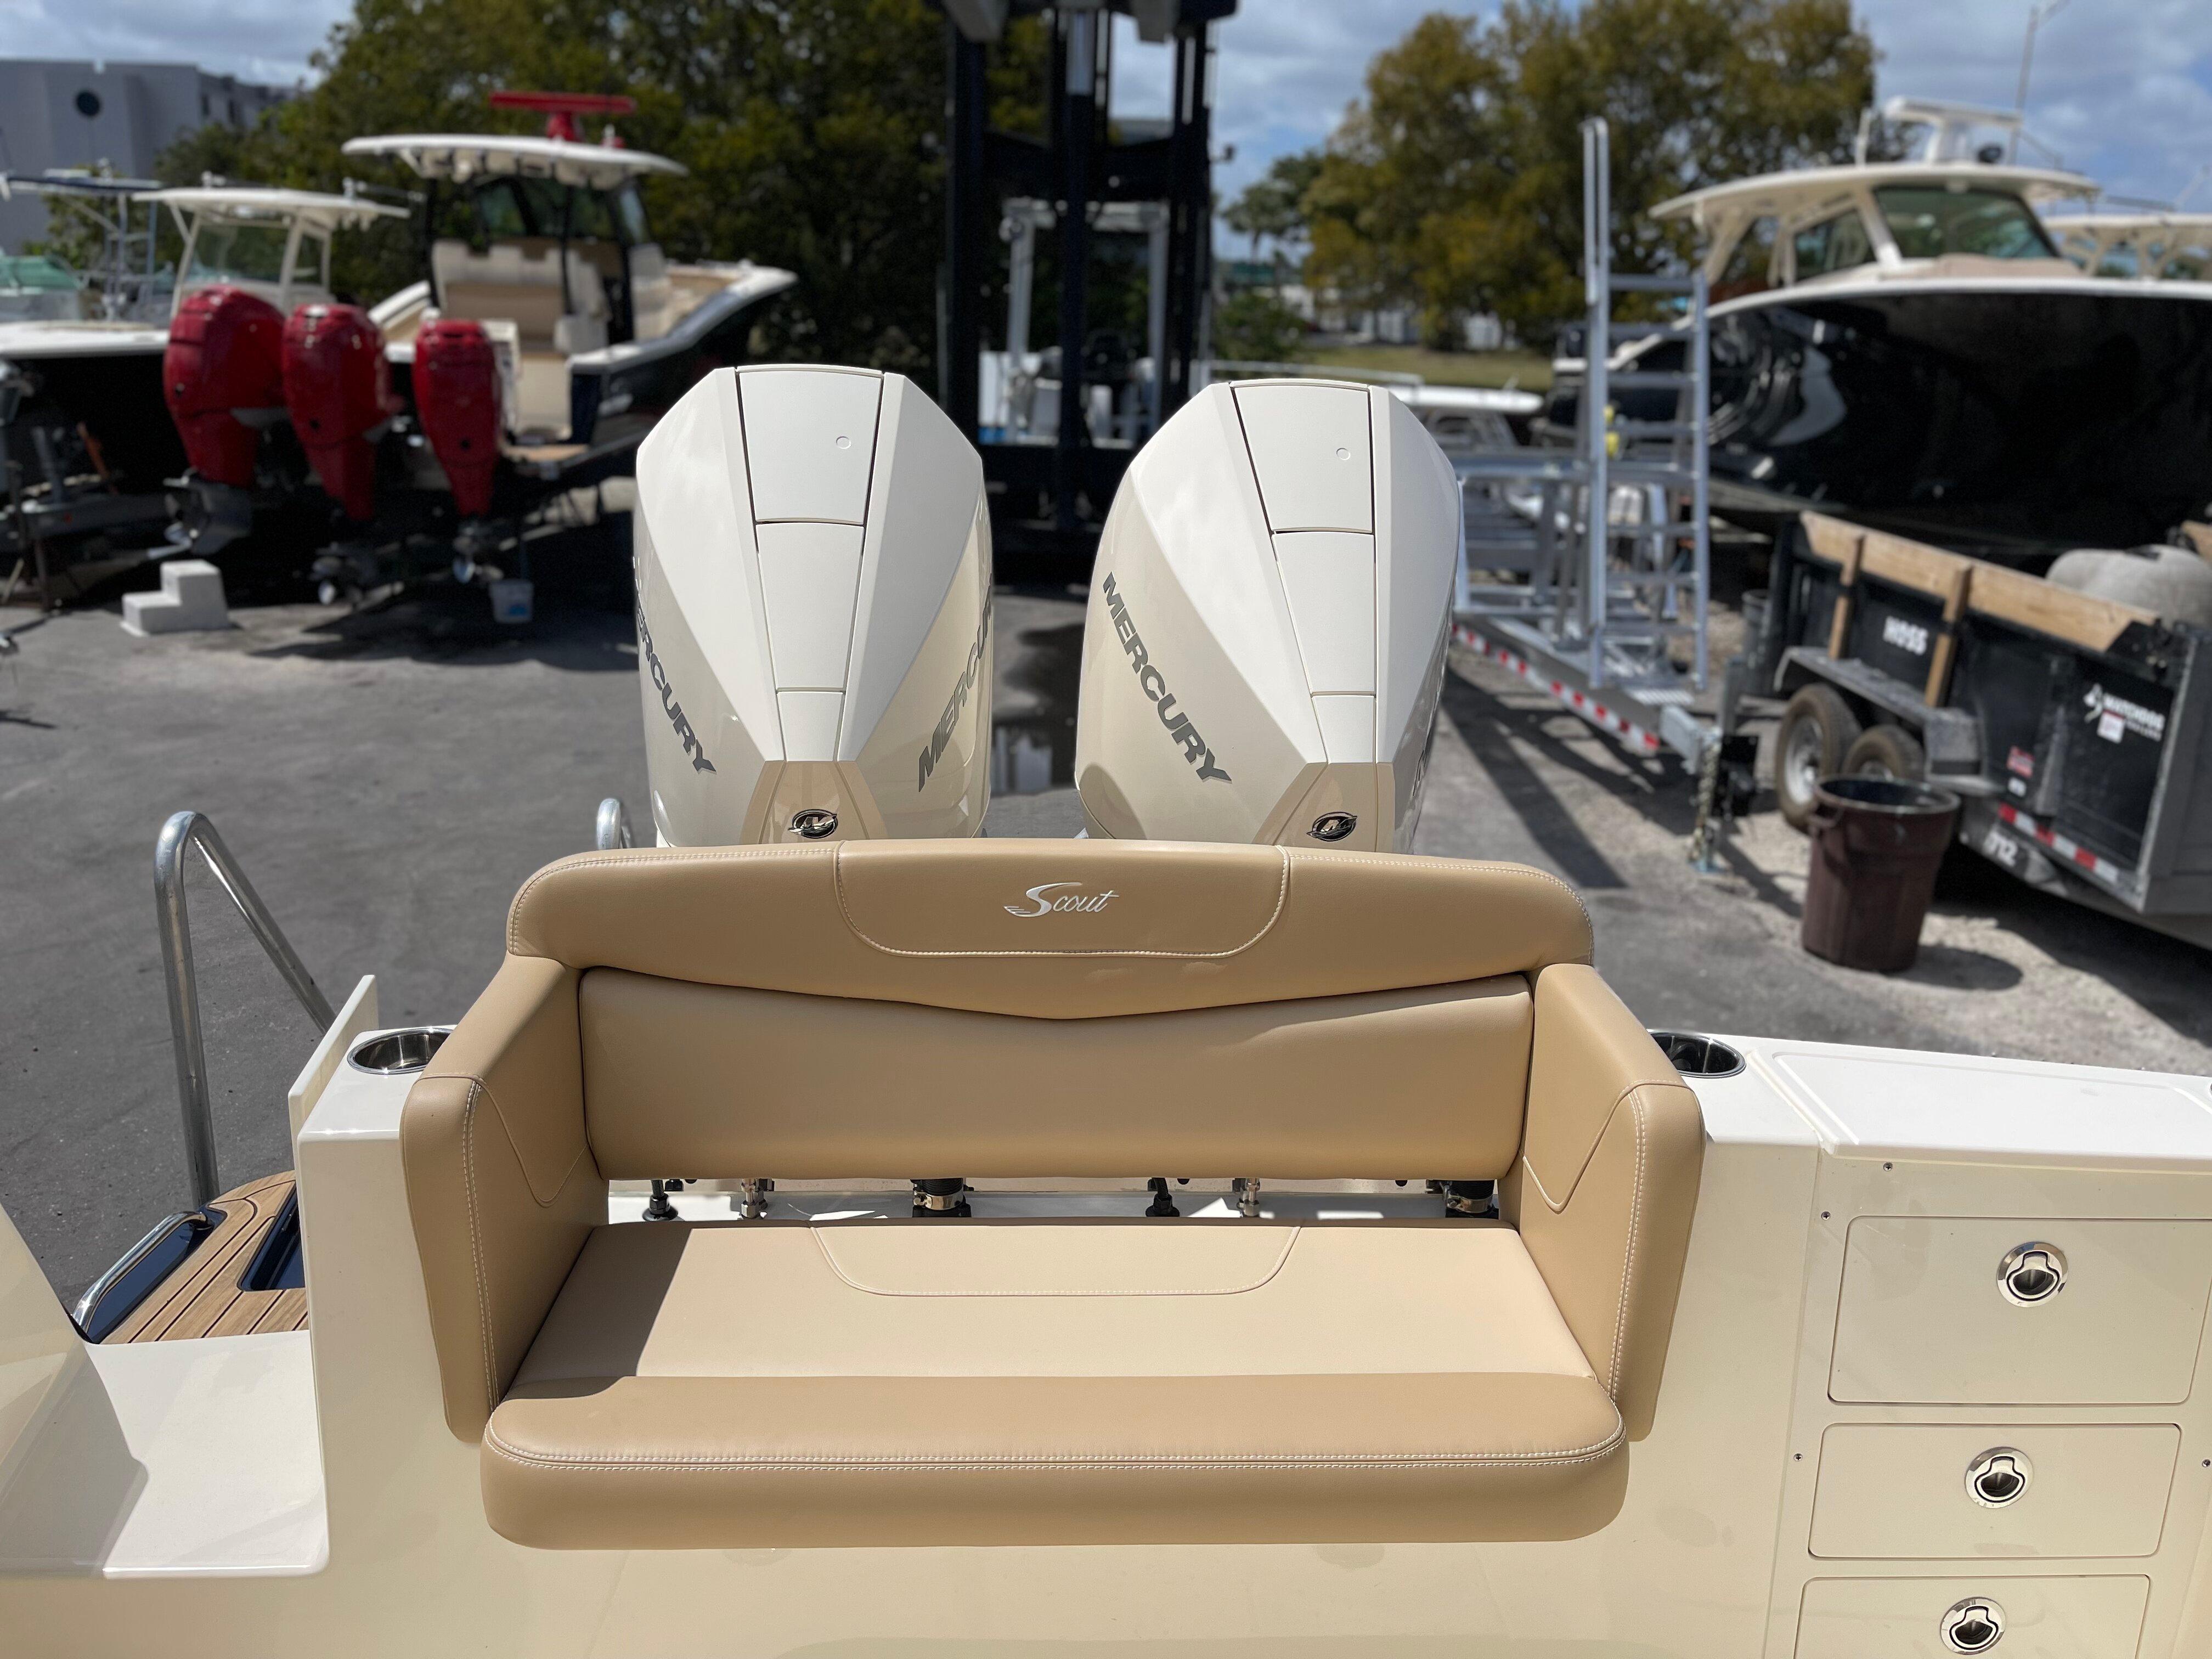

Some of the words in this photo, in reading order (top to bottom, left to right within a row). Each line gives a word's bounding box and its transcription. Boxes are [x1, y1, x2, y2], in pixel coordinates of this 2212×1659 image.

[636, 592, 716, 773] ERCURY
[918, 577, 991, 792] MERCU
[1103, 572, 1232, 783] MERCURY
[1003, 882, 1120, 917] Scout
